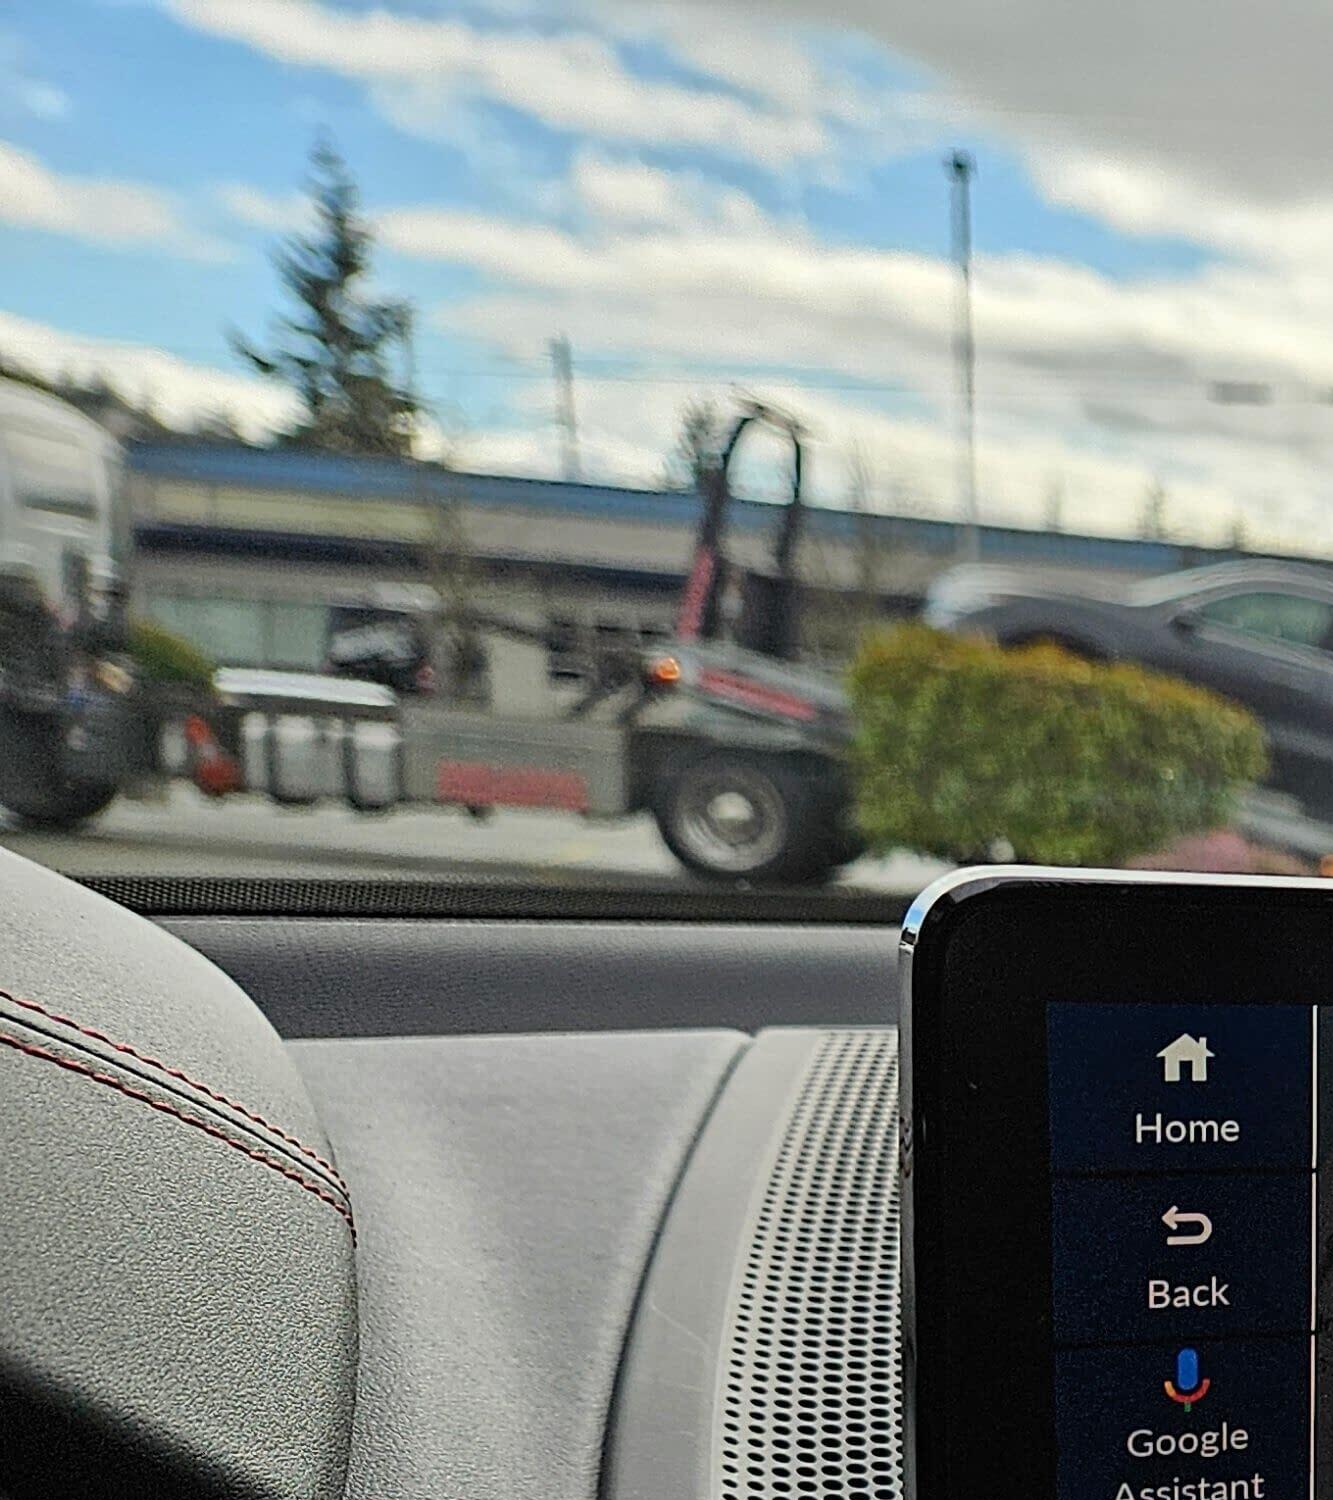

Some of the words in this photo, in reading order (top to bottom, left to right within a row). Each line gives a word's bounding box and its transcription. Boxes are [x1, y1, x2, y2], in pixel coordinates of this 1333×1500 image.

[1135, 1114, 1241, 1145] Home
[1148, 1278, 1230, 1310] Back
[1127, 1424, 1249, 1462] Google
